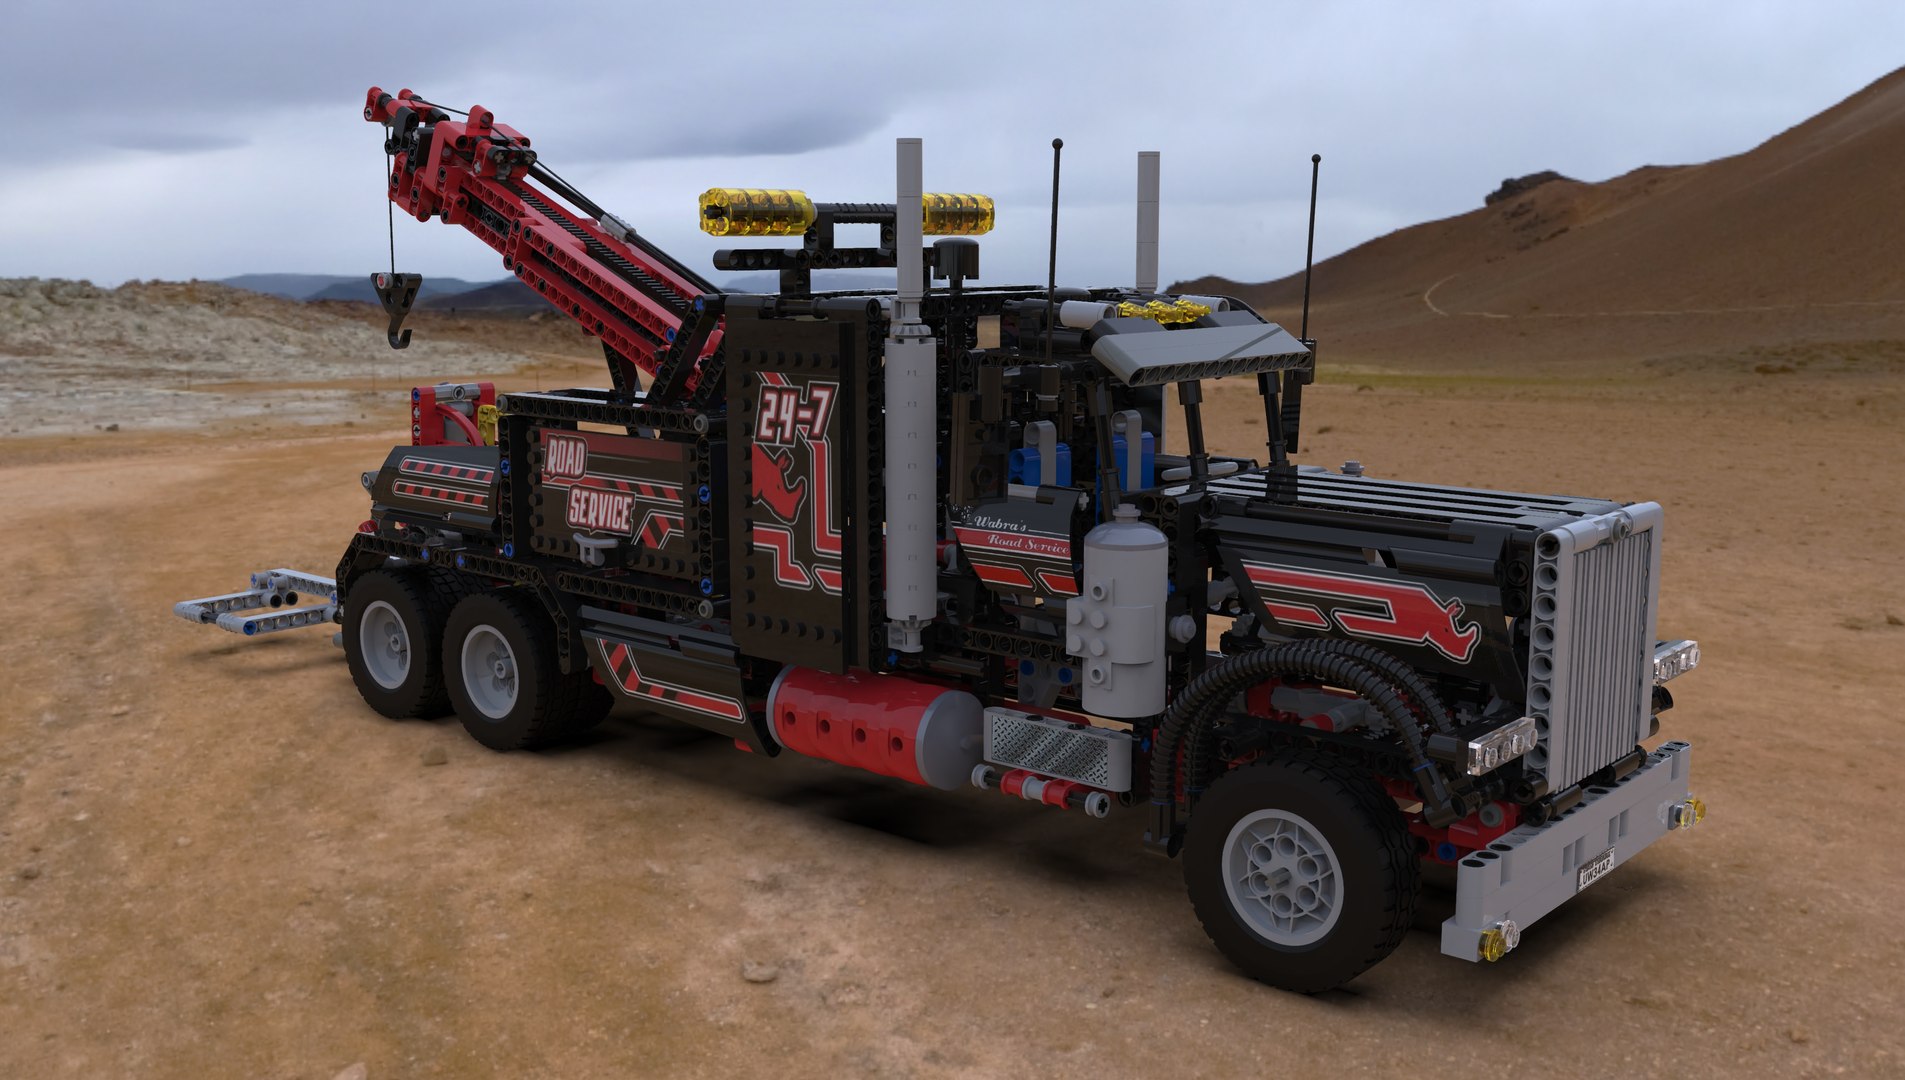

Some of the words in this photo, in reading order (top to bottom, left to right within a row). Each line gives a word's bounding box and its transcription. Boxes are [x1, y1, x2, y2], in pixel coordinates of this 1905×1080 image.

[759, 388, 832, 440] 24-7
[547, 438, 586, 476] ROAD
[569, 488, 633, 531] SERVICE
[974, 515, 1027, 532] Wabra's
[987, 534, 1022, 548] Road
[1024, 539, 1070, 554] Service
